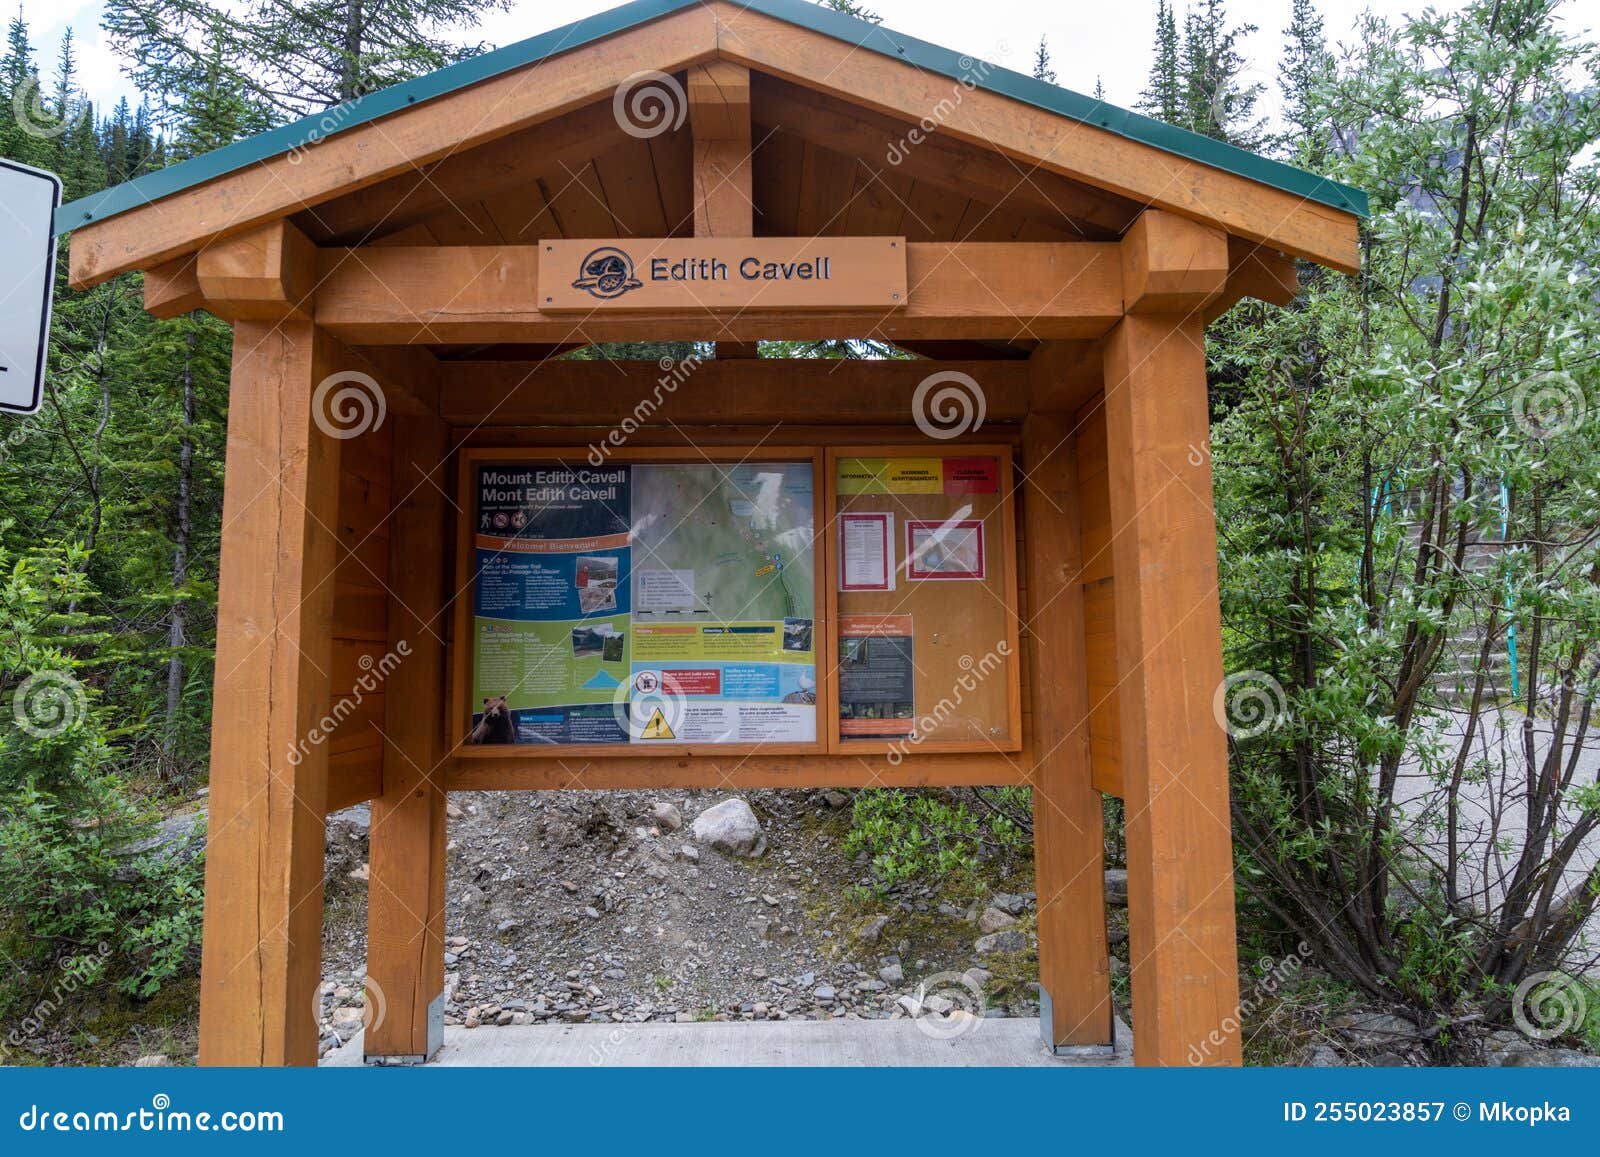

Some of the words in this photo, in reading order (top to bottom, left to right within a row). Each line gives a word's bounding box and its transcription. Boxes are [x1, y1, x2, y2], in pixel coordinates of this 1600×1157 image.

[651, 257, 728, 281] Edith
[739, 257, 832, 280] Cavell
[483, 472, 531, 485] Mount
[536, 471, 576, 485] Edith
[579, 470, 626, 484] Cavell
[483, 488, 522, 502] Mont
[526, 487, 565, 502] Edith
[569, 487, 617, 501] Cavell
